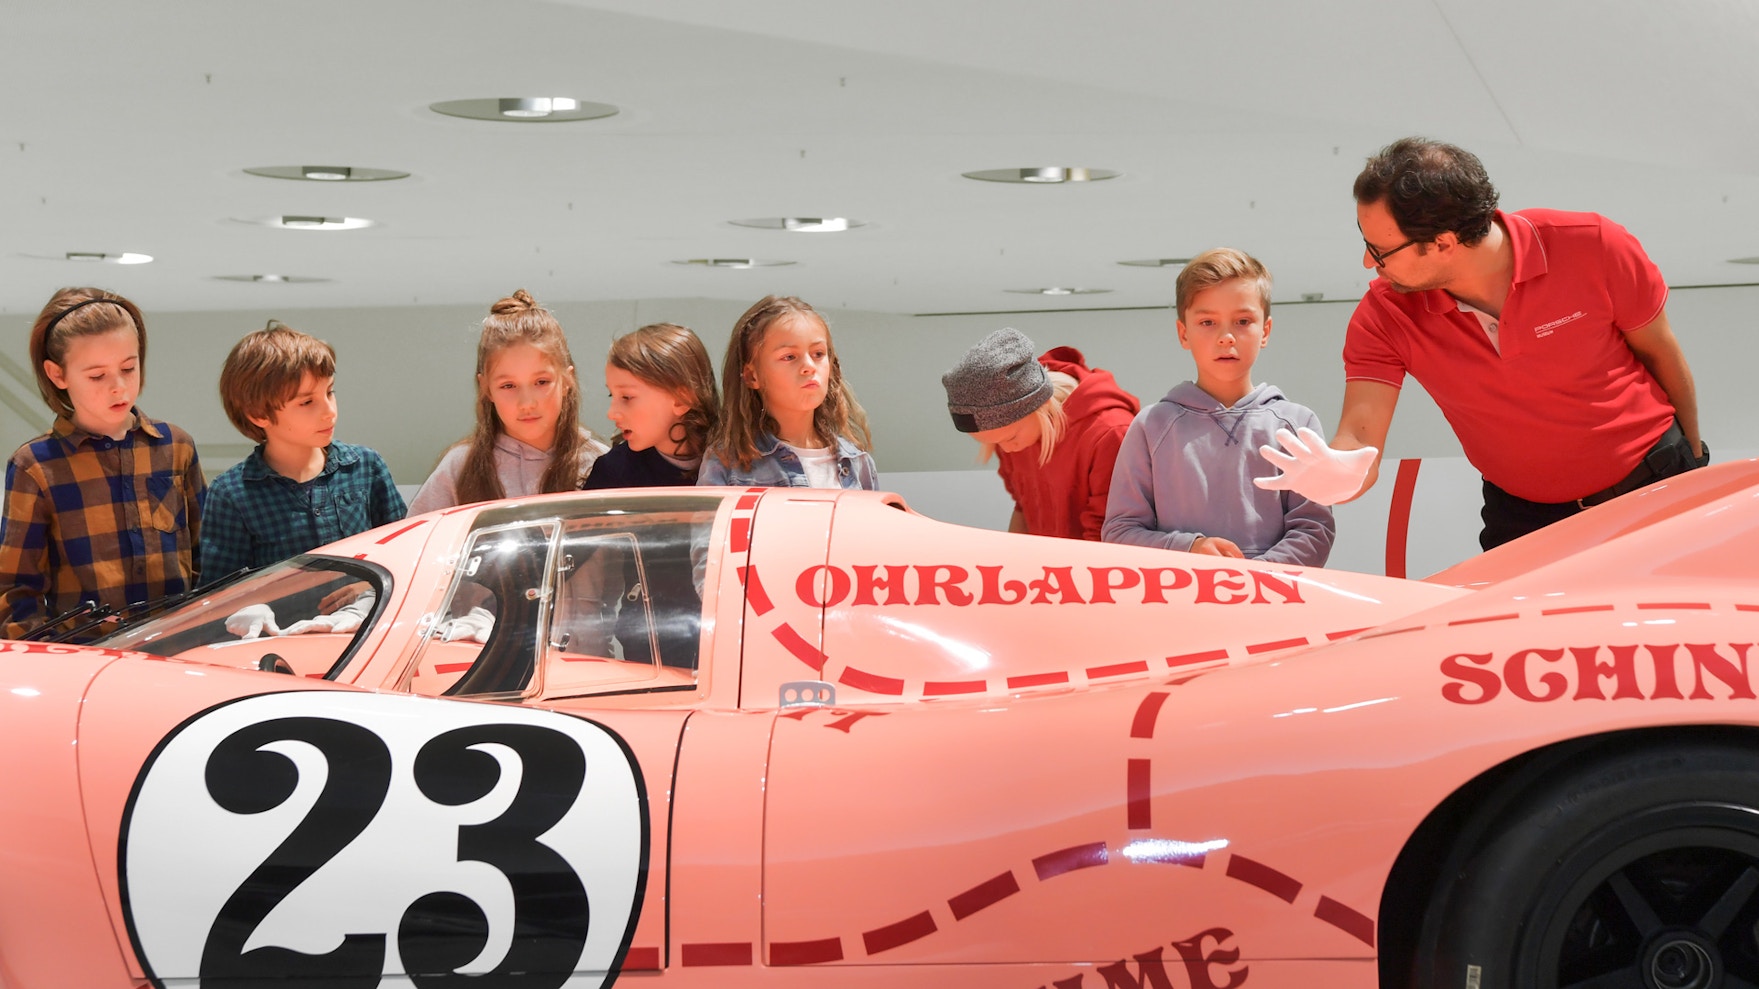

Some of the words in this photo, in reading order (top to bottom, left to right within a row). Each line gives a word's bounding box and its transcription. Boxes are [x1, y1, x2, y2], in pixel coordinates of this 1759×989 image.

[1534, 310, 1582, 332] PORSCHE
[795, 564, 1306, 608] OHRLAPPEN
[1440, 642, 1759, 705] SCHIN
[199, 716, 590, 989] 23
